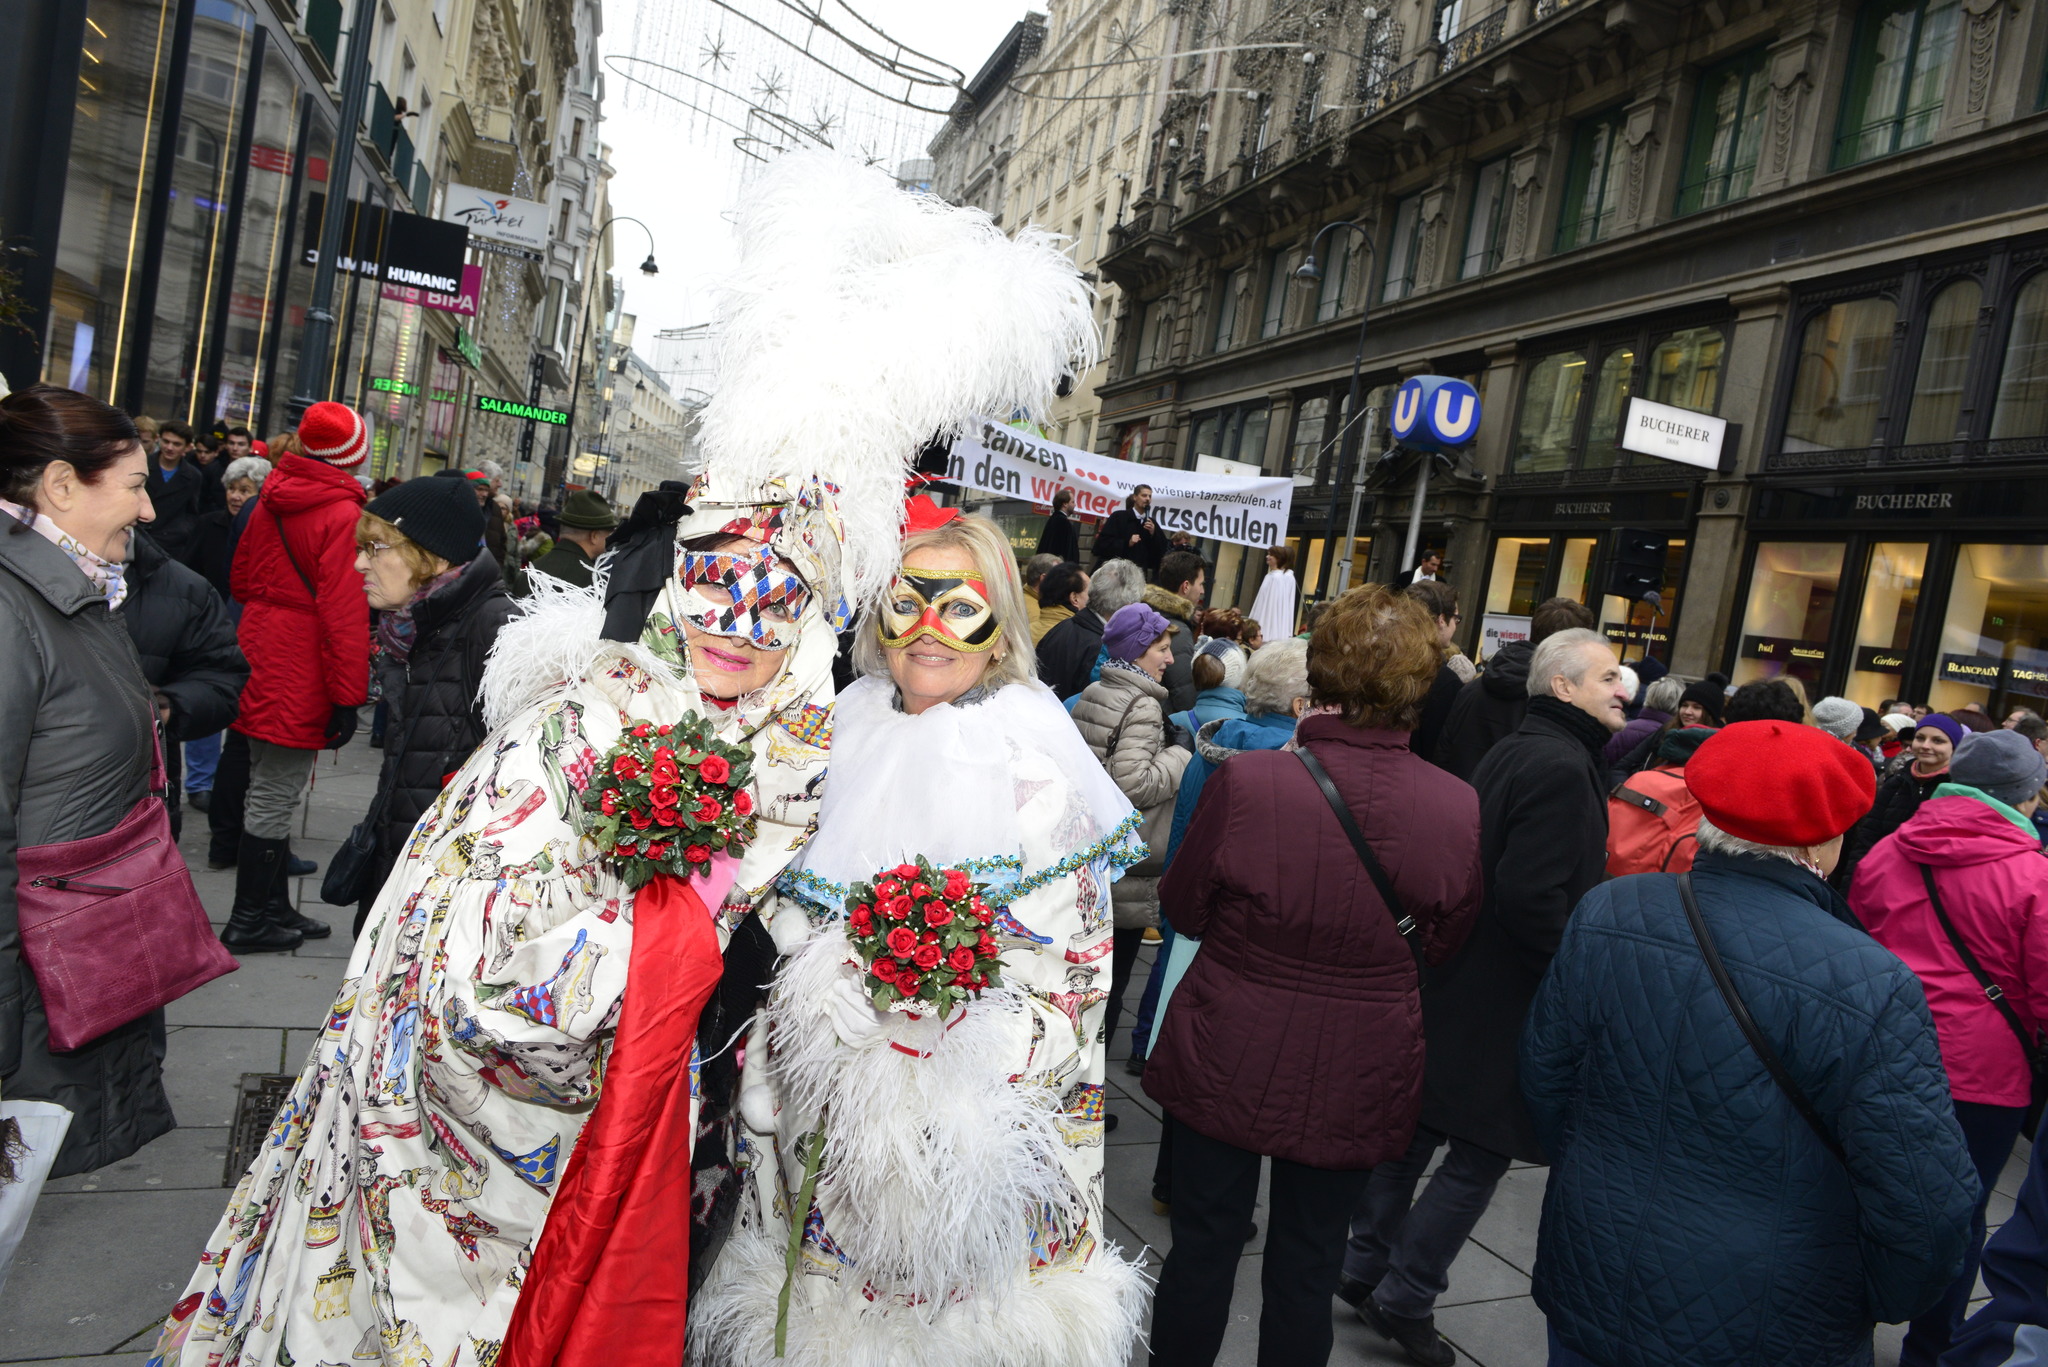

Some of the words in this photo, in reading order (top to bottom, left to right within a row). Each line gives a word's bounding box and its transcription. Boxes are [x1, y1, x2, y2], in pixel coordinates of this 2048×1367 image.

[454, 205, 526, 228] Türkei
[496, 230, 539, 245] INFORMATION
[387, 266, 458, 292] HUMANIC
[427, 291, 475, 312] BIPA
[480, 397, 568, 425] SALAMANDER
[1394, 387, 1421, 433] U
[1434, 388, 1476, 438] U
[1640, 415, 1710, 443] BUCHERER
[982, 423, 1068, 473] tanzen
[974, 454, 1021, 495] den
[1151, 504, 1278, 547] nzschulen
[1555, 502, 1612, 514] BUCHERER
[1855, 492, 1953, 510] BUCHERER
[1009, 537, 1037, 550] PALMERS
[1486, 628, 1498, 638] die
[1500, 630, 1527, 640] wiener
[1606, 629, 1636, 639] BREITLNG
[1872, 655, 1902, 667] Cartier
[1947, 661, 2000, 676] BLANCPAIN
